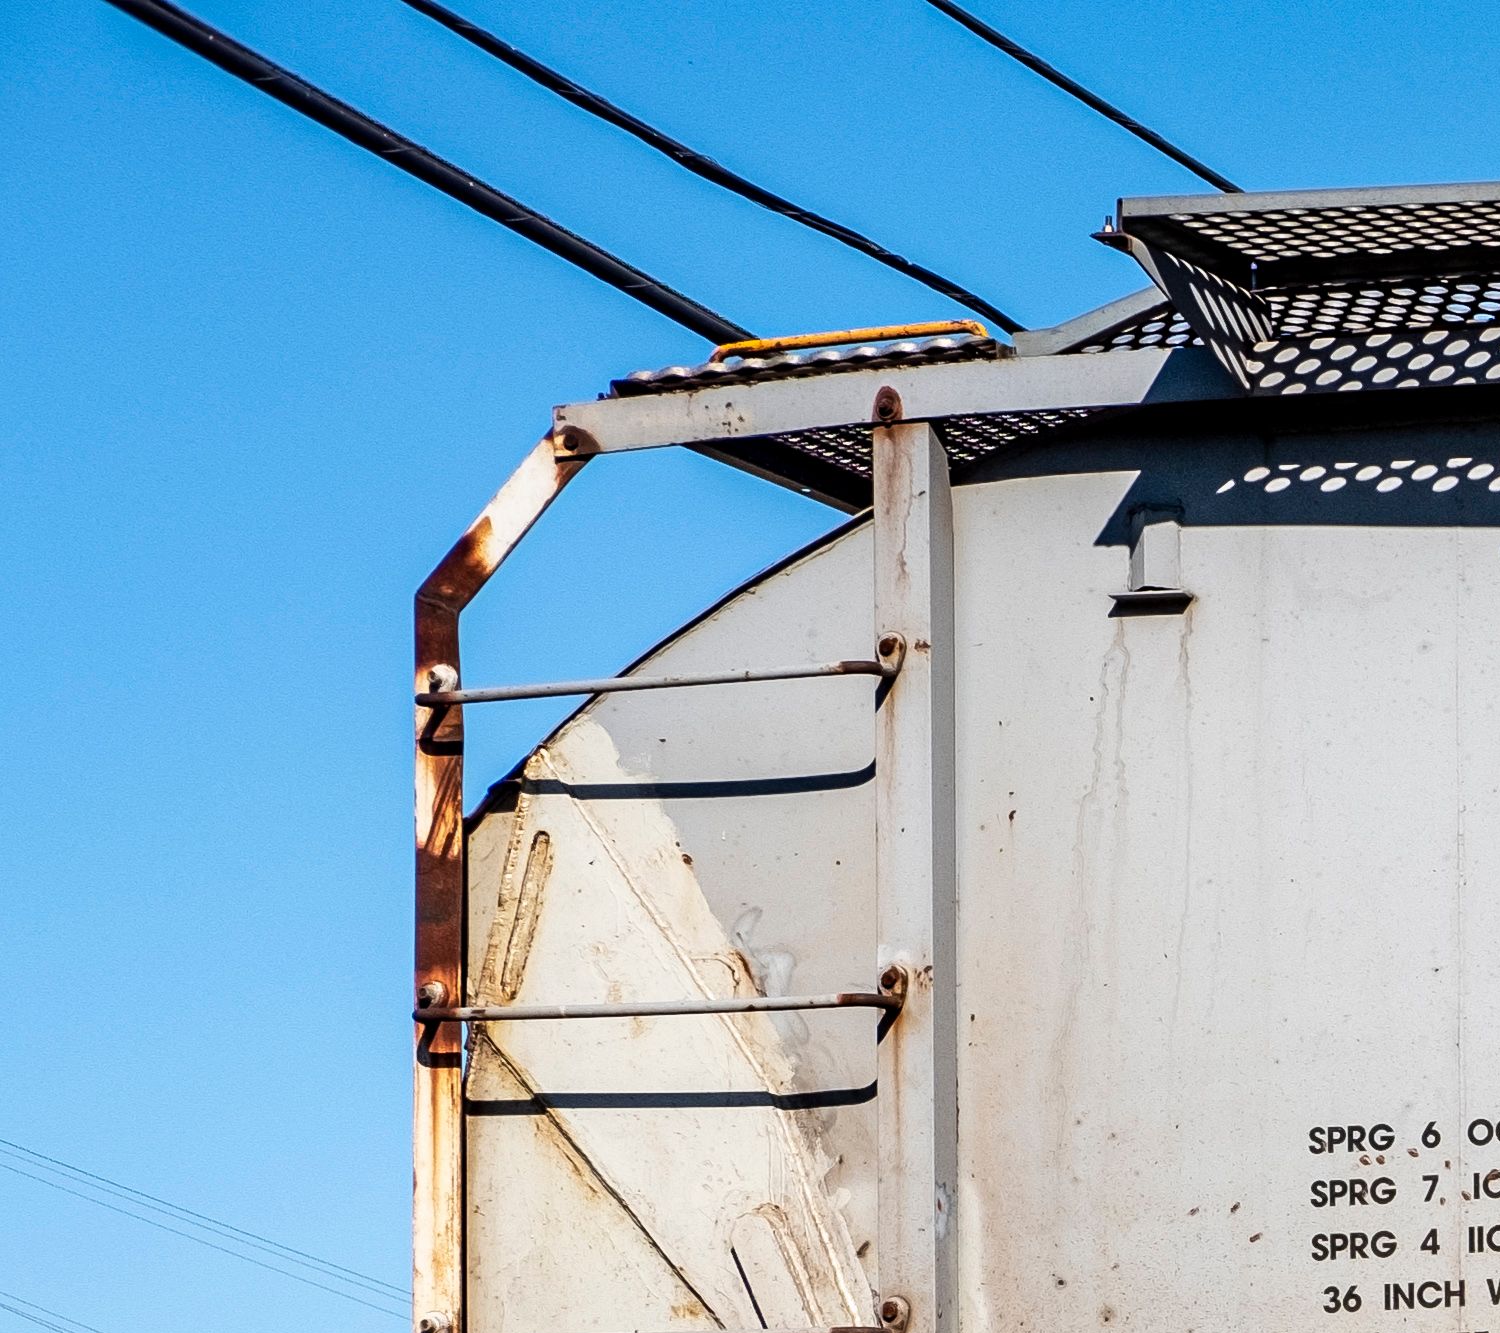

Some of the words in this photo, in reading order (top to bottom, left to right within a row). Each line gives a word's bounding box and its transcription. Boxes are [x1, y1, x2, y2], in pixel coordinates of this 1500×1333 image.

[1308, 1122, 1396, 1155] SPRG
[1421, 1121, 1441, 1149] 6
[1310, 1176, 1397, 1208] SPRG
[1421, 1174, 1440, 1203] 7
[1311, 1229, 1397, 1262] SPRG
[1420, 1228, 1441, 1256] 4
[1322, 1285, 1362, 1315] 36
[1384, 1279, 1466, 1312] INCH
